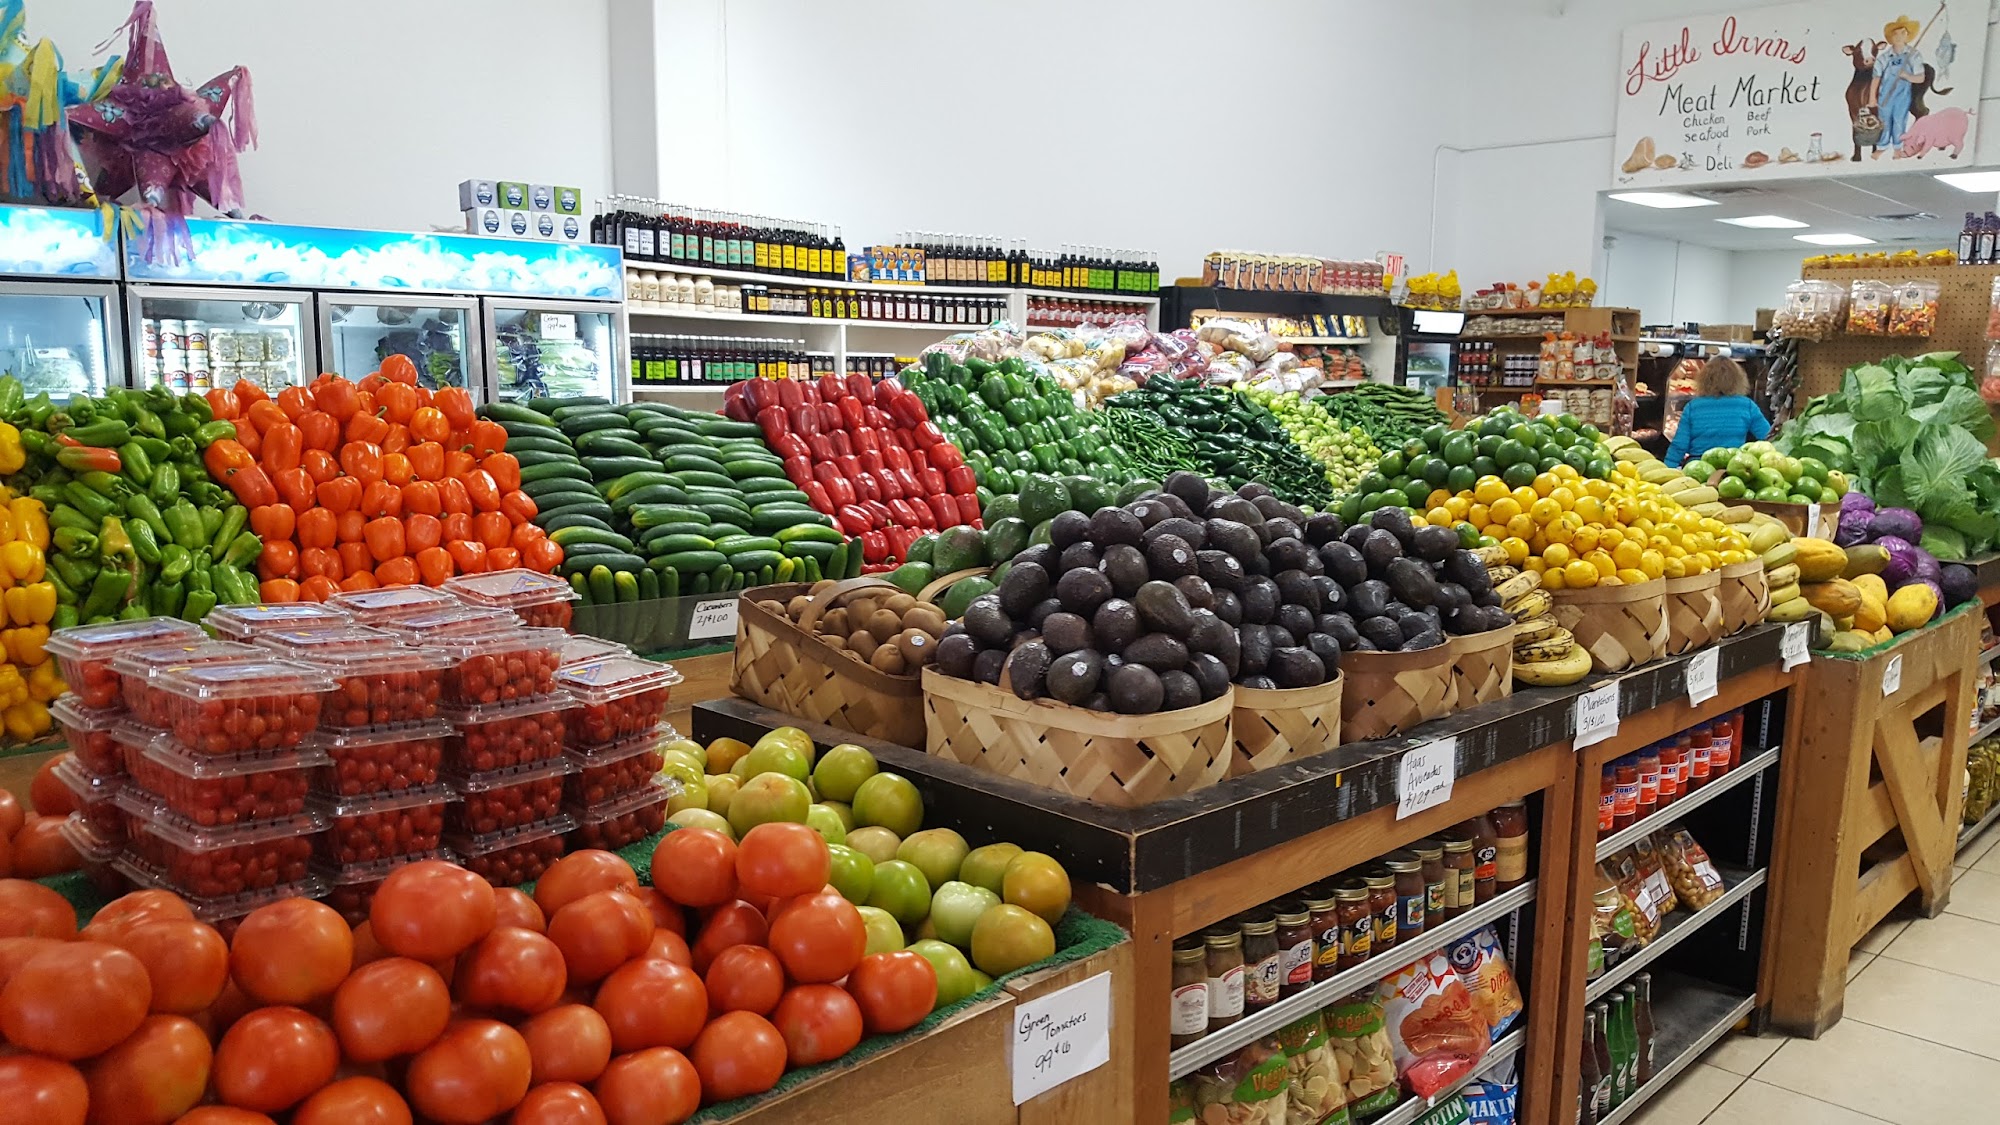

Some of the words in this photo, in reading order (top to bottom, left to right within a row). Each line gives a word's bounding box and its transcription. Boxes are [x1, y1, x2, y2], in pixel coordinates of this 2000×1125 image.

[1626, 26, 1701, 95] Little
[1659, 83, 1718, 116] Meat
[1729, 71, 1821, 108] Market
[1747, 107, 1772, 121] Beef
[1746, 123, 1772, 136] Pork
[1706, 155, 1733, 171] Deli
[1387, 254, 1403, 277] EXIT
[1018, 1012, 1051, 1042] Green
